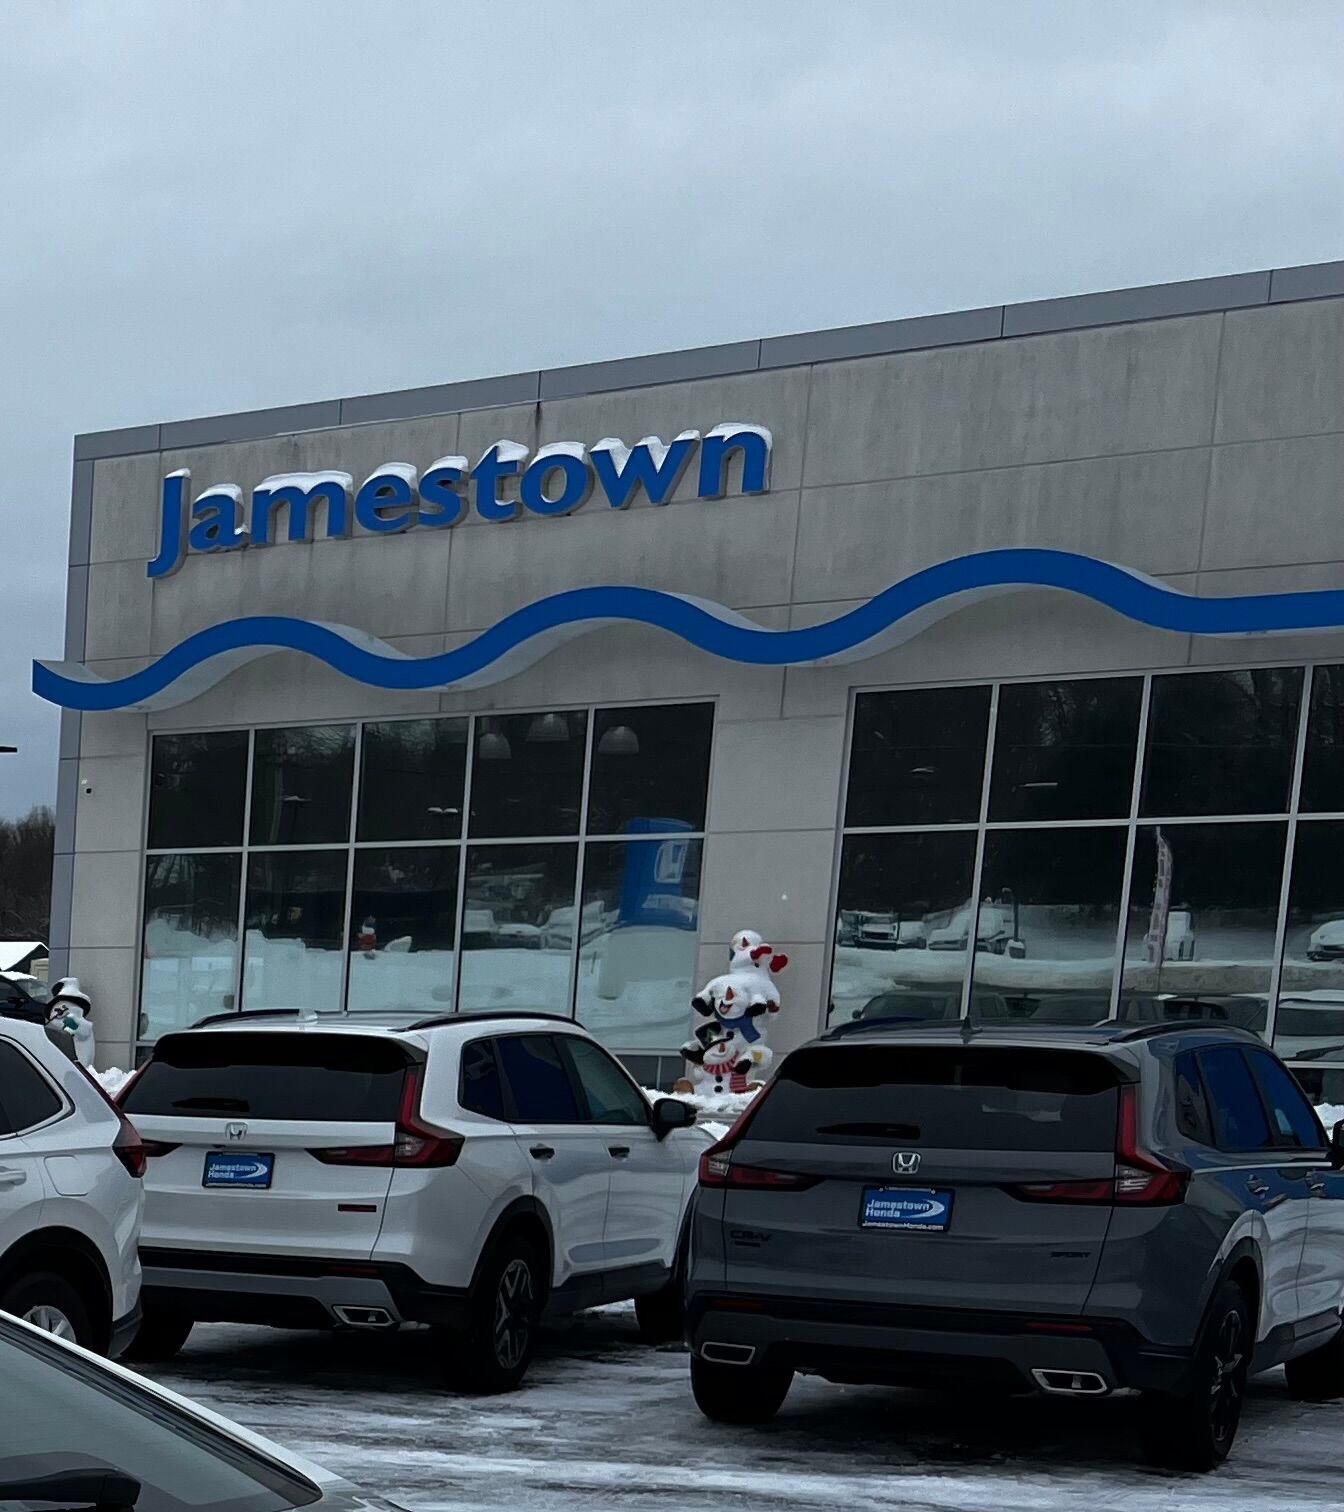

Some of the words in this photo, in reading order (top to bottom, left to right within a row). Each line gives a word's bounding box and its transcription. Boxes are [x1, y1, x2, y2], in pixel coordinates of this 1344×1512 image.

[146, 428, 768, 578] Jamestown
[866, 1199, 930, 1211] Jamestown
[865, 1207, 901, 1217] Honda
